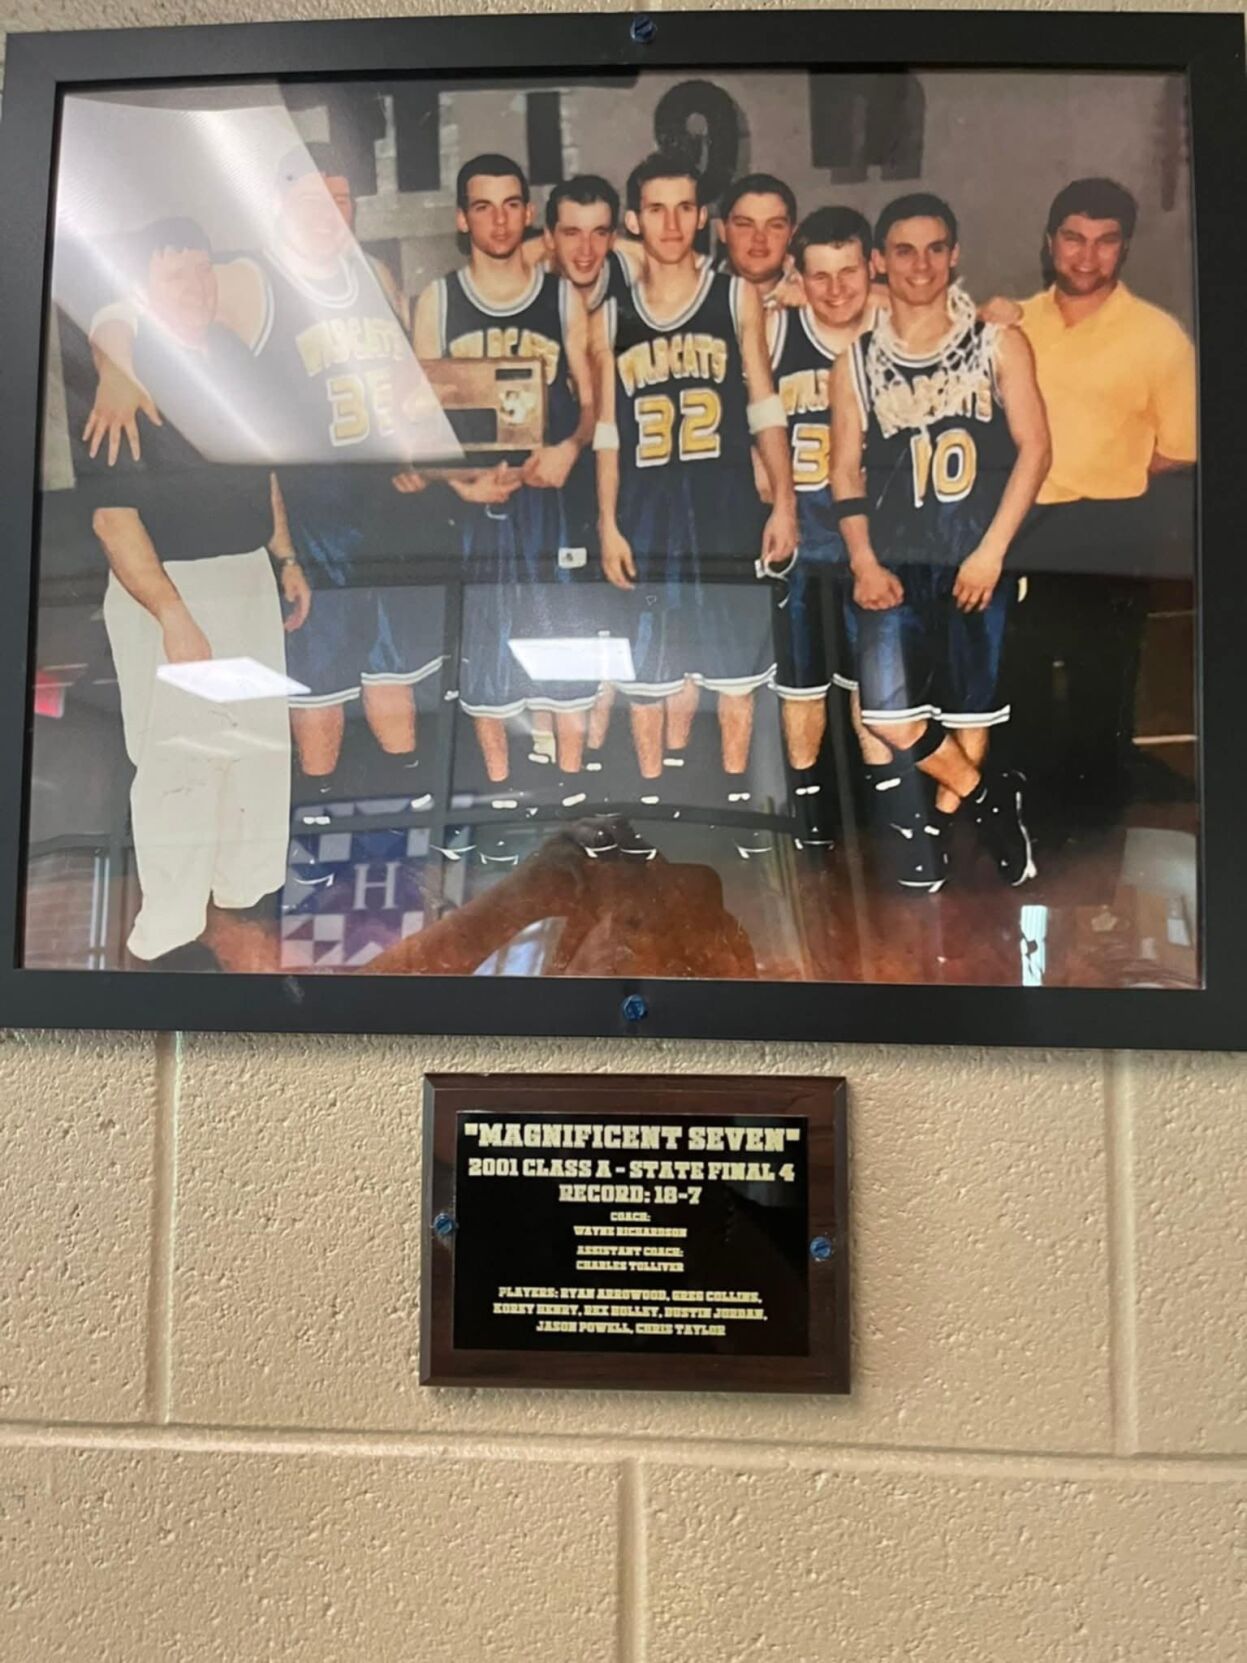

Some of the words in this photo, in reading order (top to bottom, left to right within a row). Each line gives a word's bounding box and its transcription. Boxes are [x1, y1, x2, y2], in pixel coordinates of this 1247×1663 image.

[634, 387, 721, 468] 32
[910, 428, 977, 508] 10
[464, 1123, 683, 1150] "MAGNIFICENT
[689, 1126, 801, 1152] SEVEN"
[469, 1158, 519, 1177] 2001
[523, 1158, 592, 1178] CLASS
[596, 1160, 613, 1178] A
[630, 1161, 704, 1180] STATE
[708, 1162, 775, 1181] FINAL
[779, 1163, 795, 1182] 4
[559, 1184, 651, 1204] RECORD:
[654, 1186, 703, 1205] 18-7
[611, 1211, 651, 1222] COACH:
[576, 1245, 642, 1256] ASSISTANT
[643, 1247, 684, 1258] COACH:
[499, 1287, 558, 1299] PLAYERS:
[560, 1288, 595, 1300] RYAN
[536, 1321, 578, 1333] JASON
[674, 1324, 726, 1336] TAYLOR
